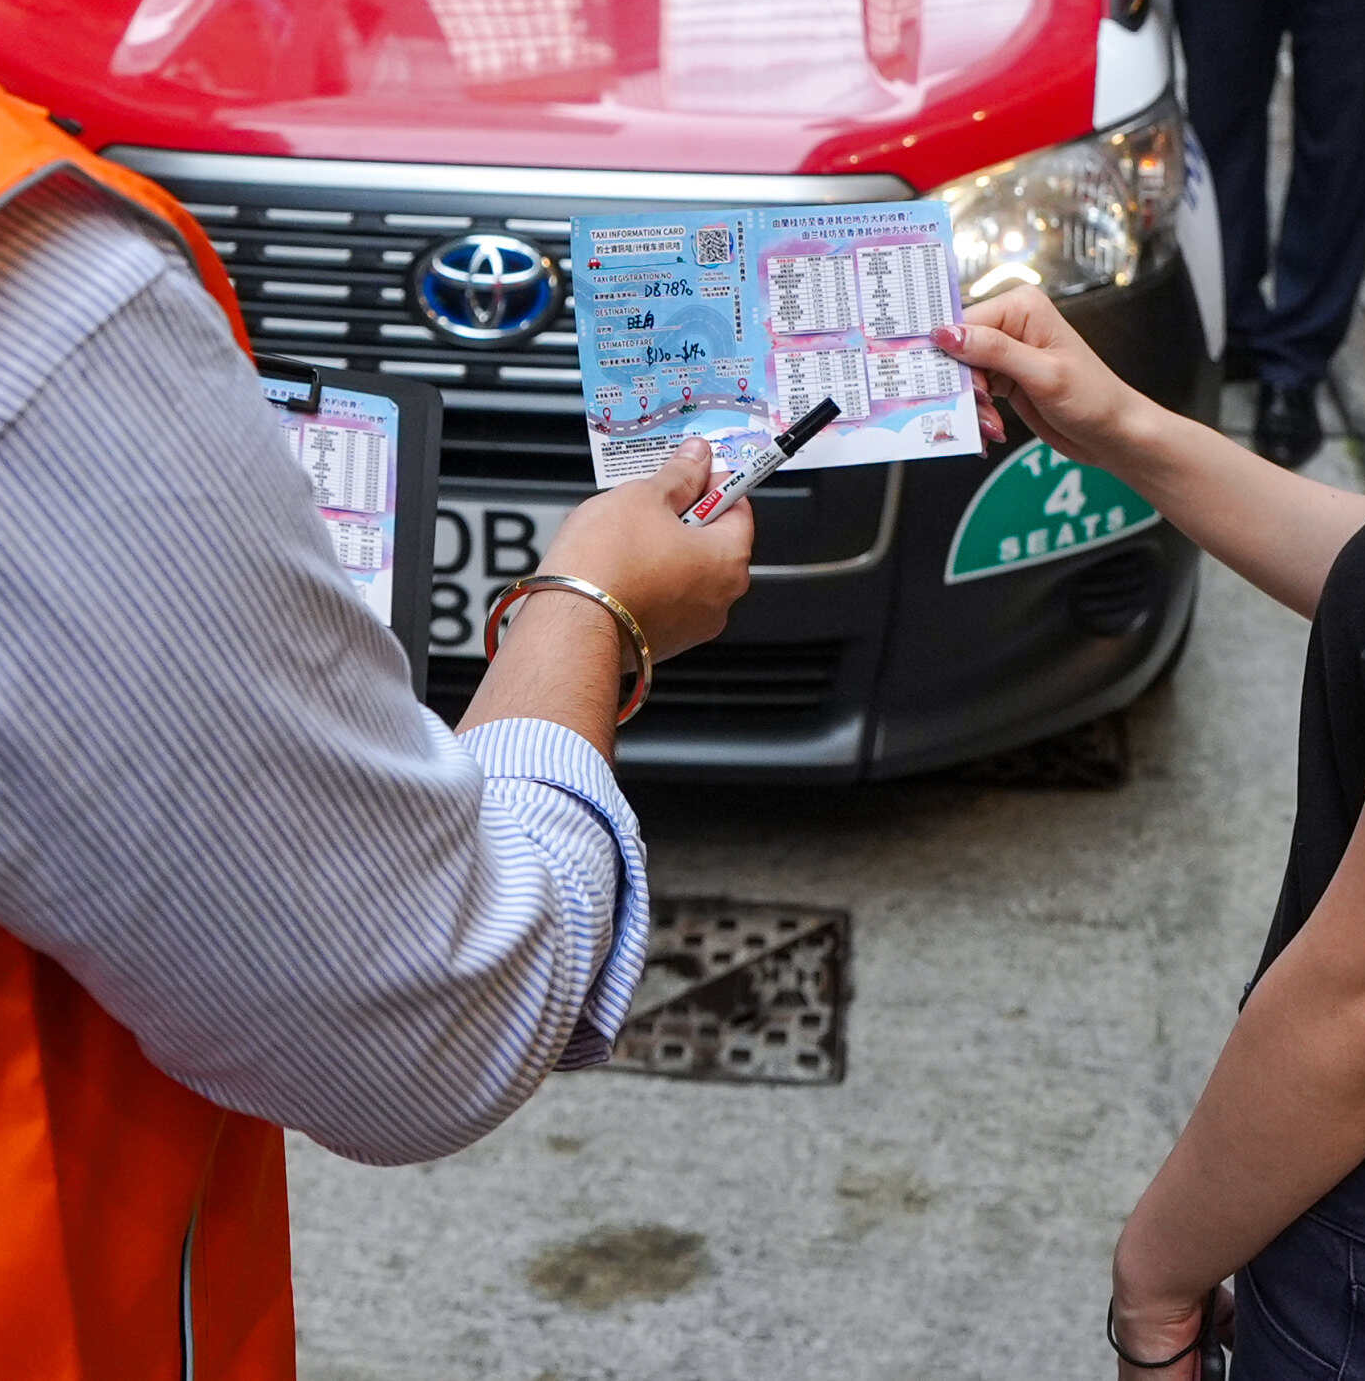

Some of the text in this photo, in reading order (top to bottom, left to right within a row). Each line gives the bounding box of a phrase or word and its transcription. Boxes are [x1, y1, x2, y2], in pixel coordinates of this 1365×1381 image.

[591, 227, 685, 240] TAXI INFORMATION CARD
[593, 275, 608, 283] TAXI
[608, 273, 659, 282] REGISTRATION
[595, 307, 641, 317] DESTINATION
[598, 338, 653, 350] ESTIMATED FARE
[722, 472, 746, 493] PEN
[1044, 468, 1087, 516] 4
[998, 504, 1127, 563] SEATS
